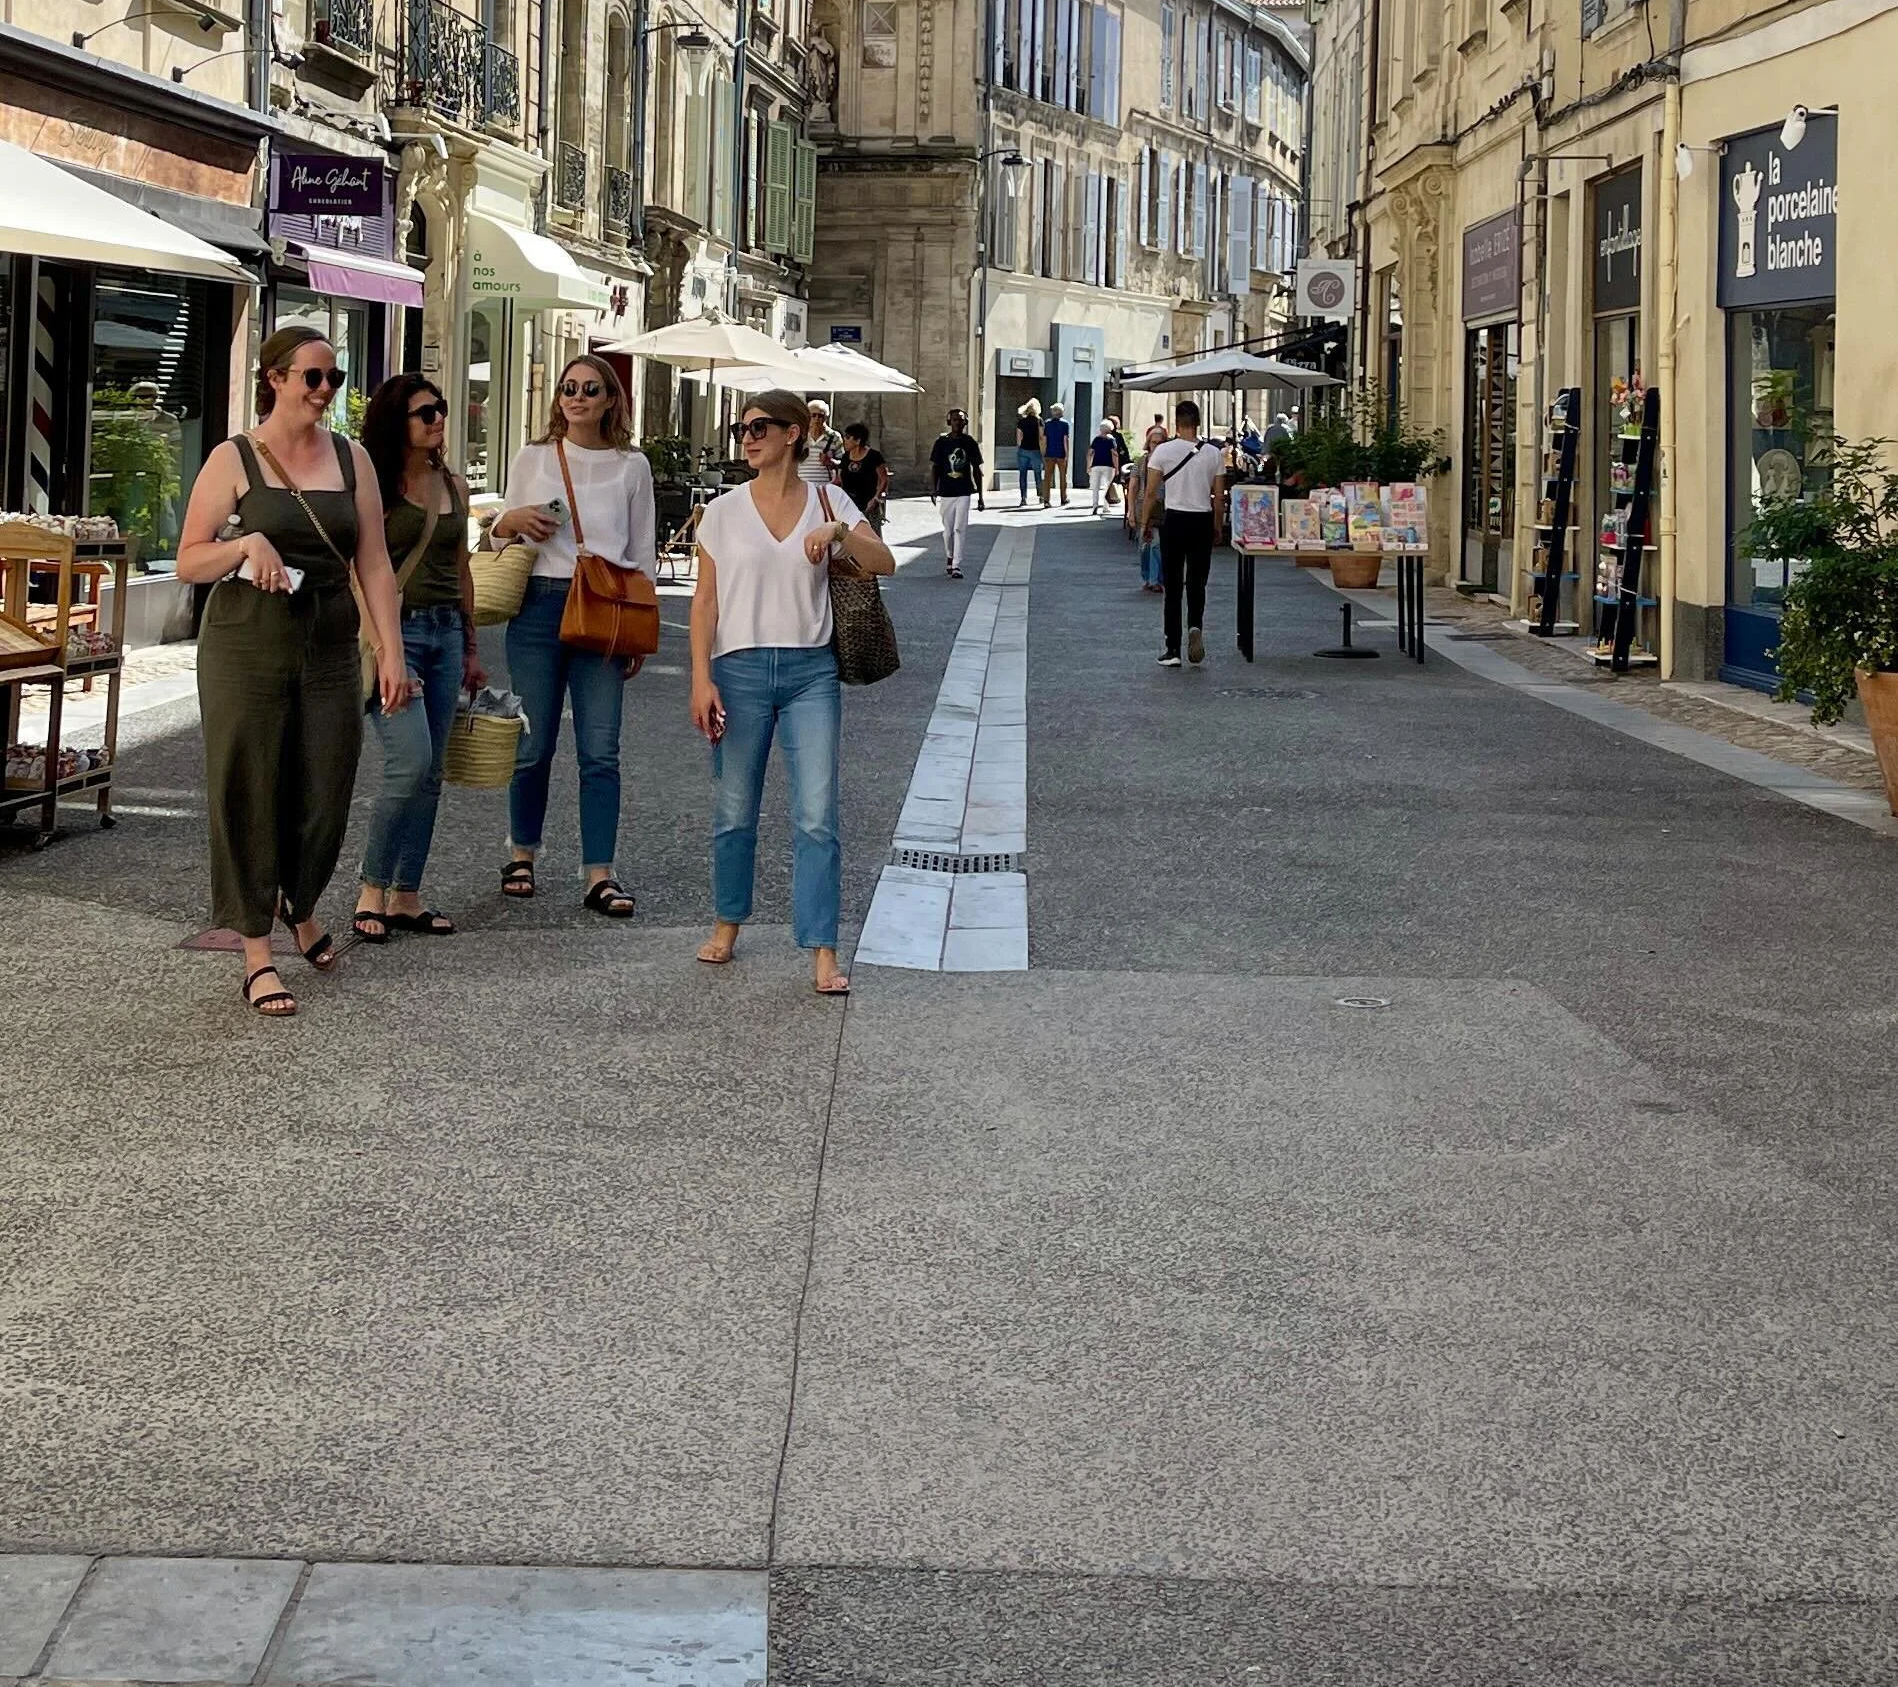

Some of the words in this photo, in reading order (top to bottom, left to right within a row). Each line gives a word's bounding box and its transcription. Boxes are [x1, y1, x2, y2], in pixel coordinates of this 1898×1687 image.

[1769, 151, 1781, 186] la
[1768, 179, 1839, 232] porcelaine
[473, 250, 482, 261] à
[1767, 230, 1823, 270] blanche
[473, 266, 496, 277] nos
[472, 280, 521, 292] amours
